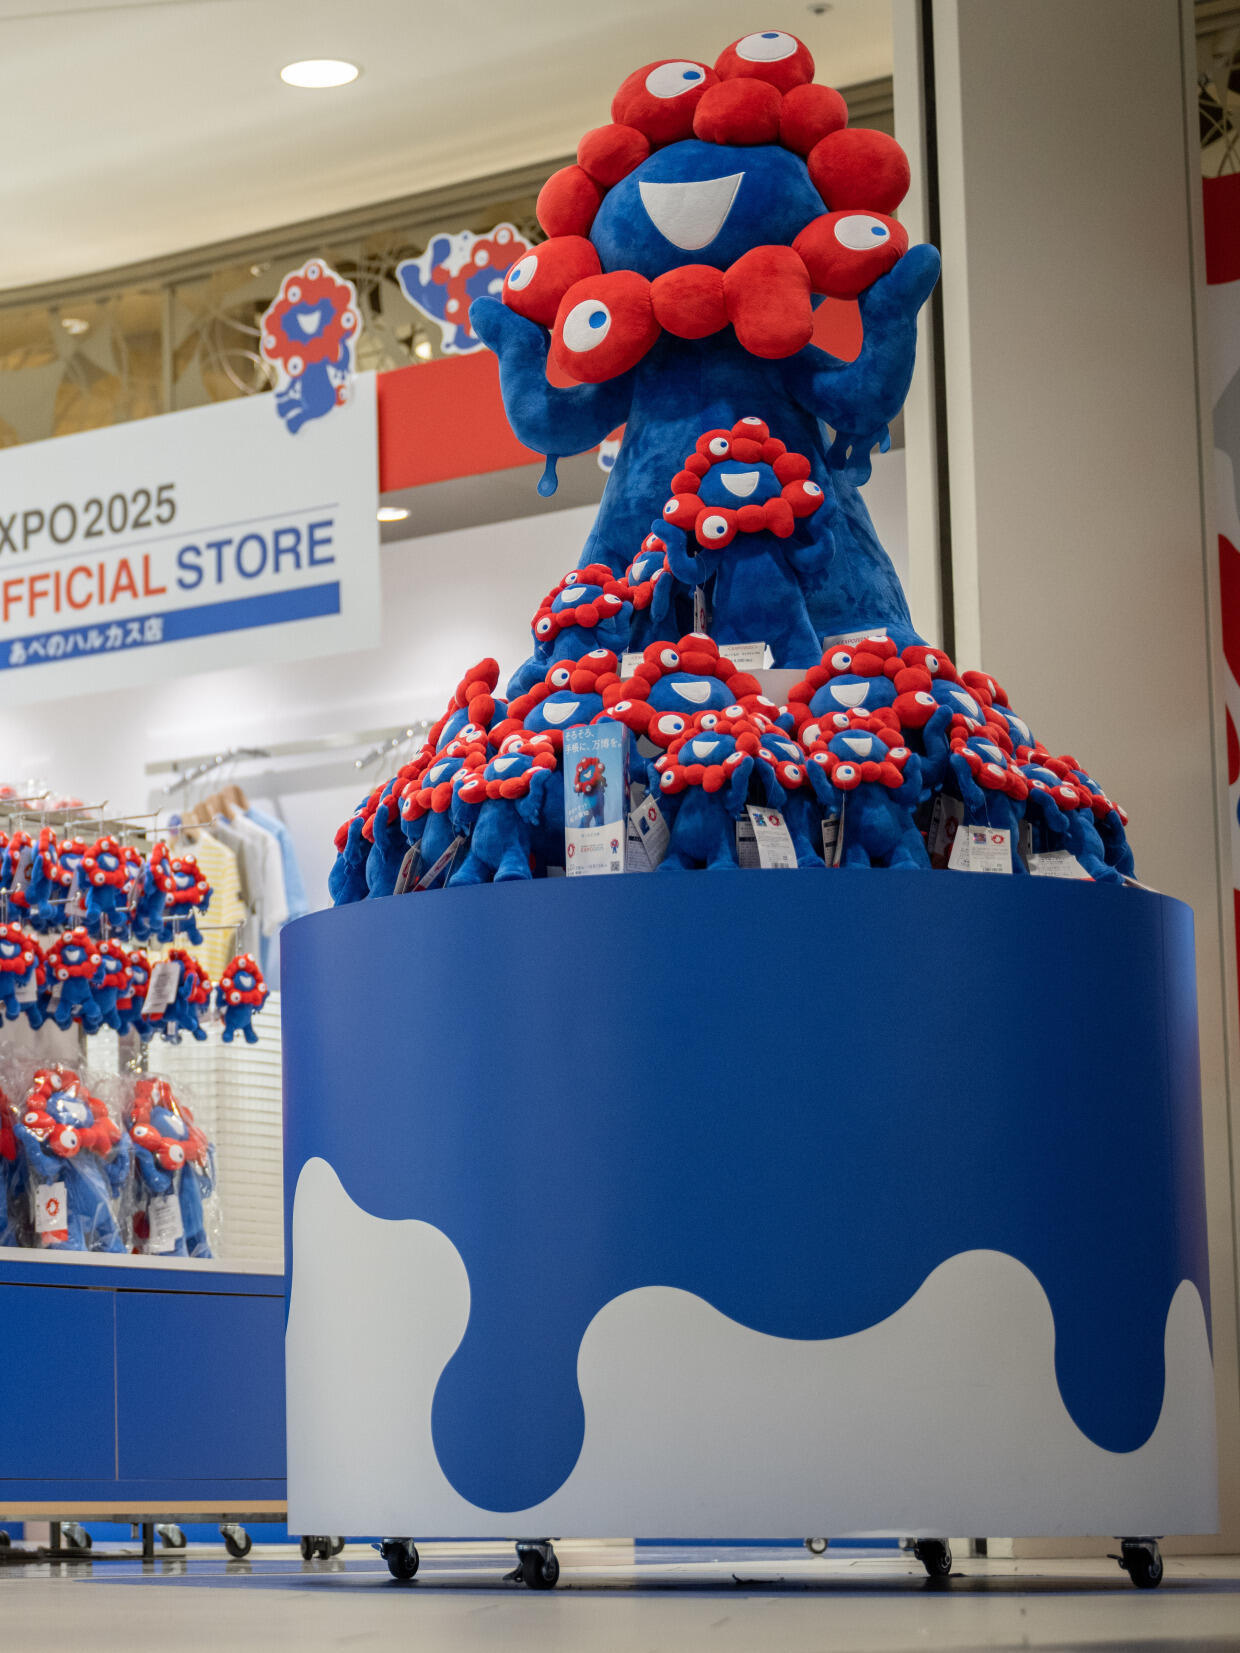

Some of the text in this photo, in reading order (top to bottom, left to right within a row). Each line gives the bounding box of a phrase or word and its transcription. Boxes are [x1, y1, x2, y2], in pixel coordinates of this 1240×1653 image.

[176, 519, 336, 591] STORE
[8, 617, 164, 666] あべのハルカス店
